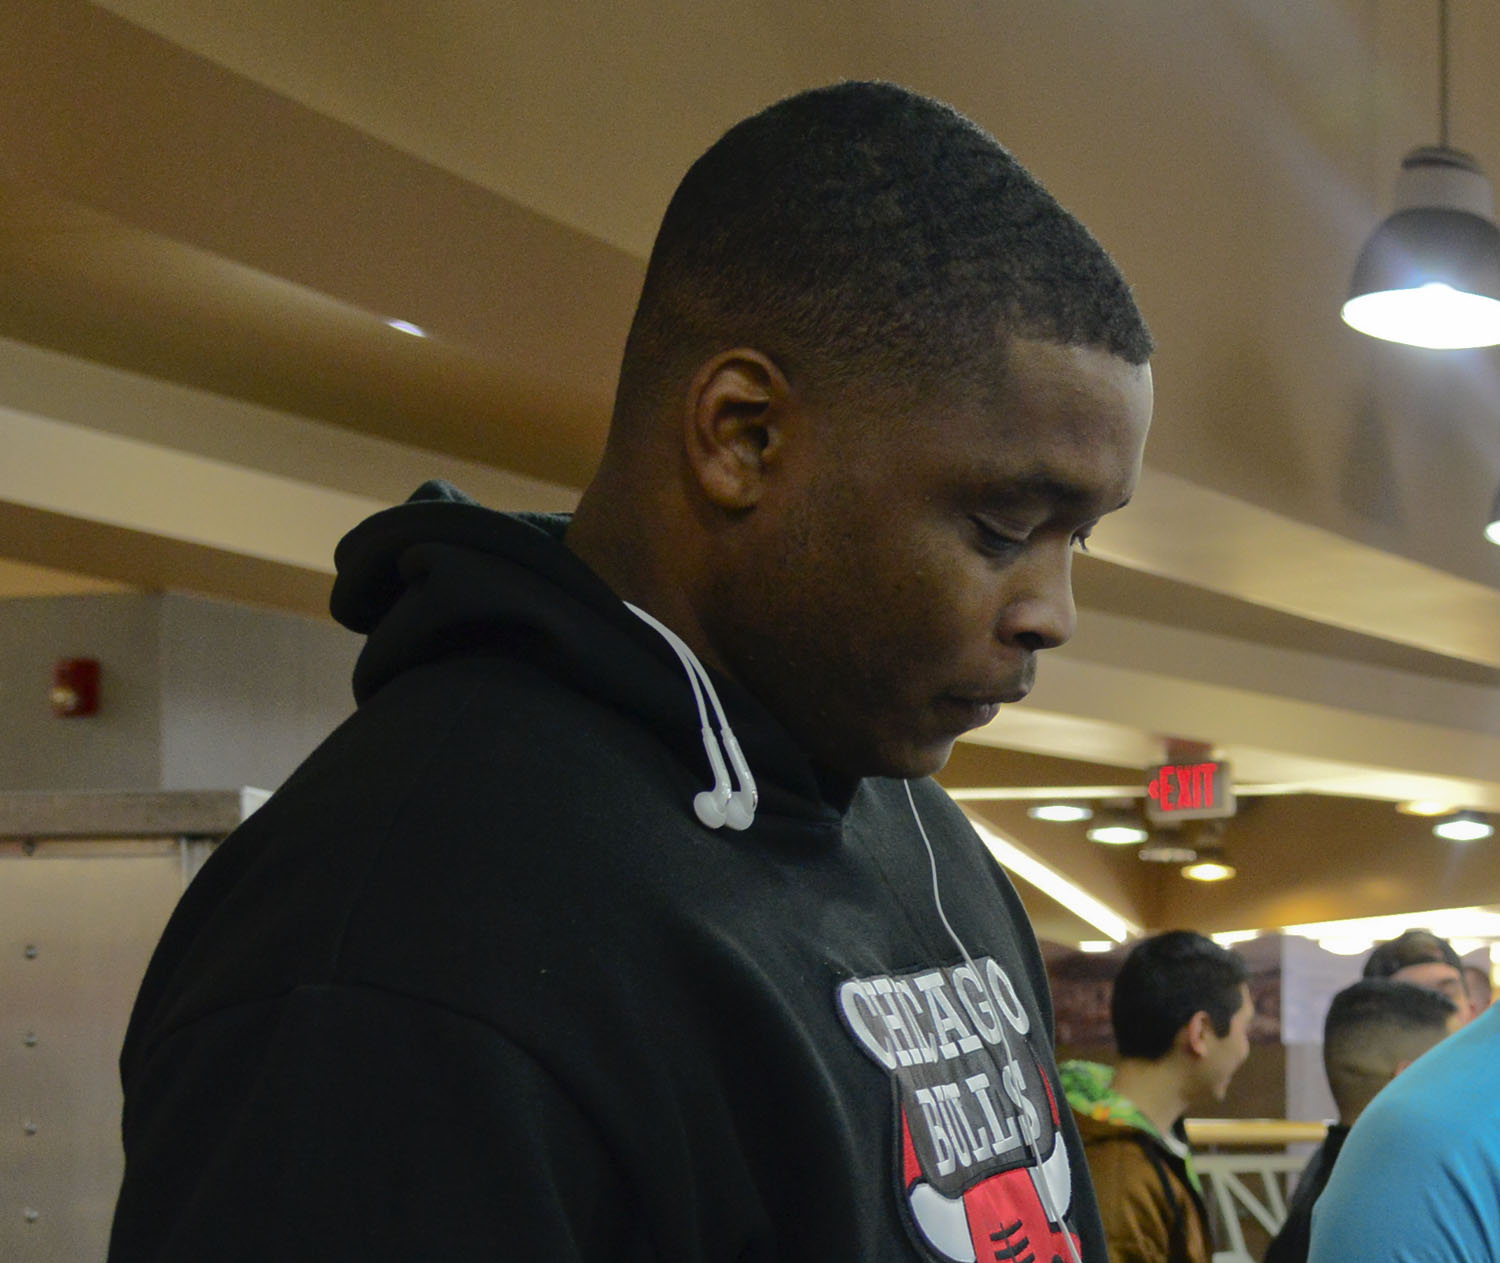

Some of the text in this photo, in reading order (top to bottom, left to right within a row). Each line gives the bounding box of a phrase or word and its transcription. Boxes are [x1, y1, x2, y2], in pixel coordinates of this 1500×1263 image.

[1160, 764, 1217, 812] EXIT
[840, 958, 1029, 1069] CHICAGO
[917, 1060, 1041, 1176] BULLS
